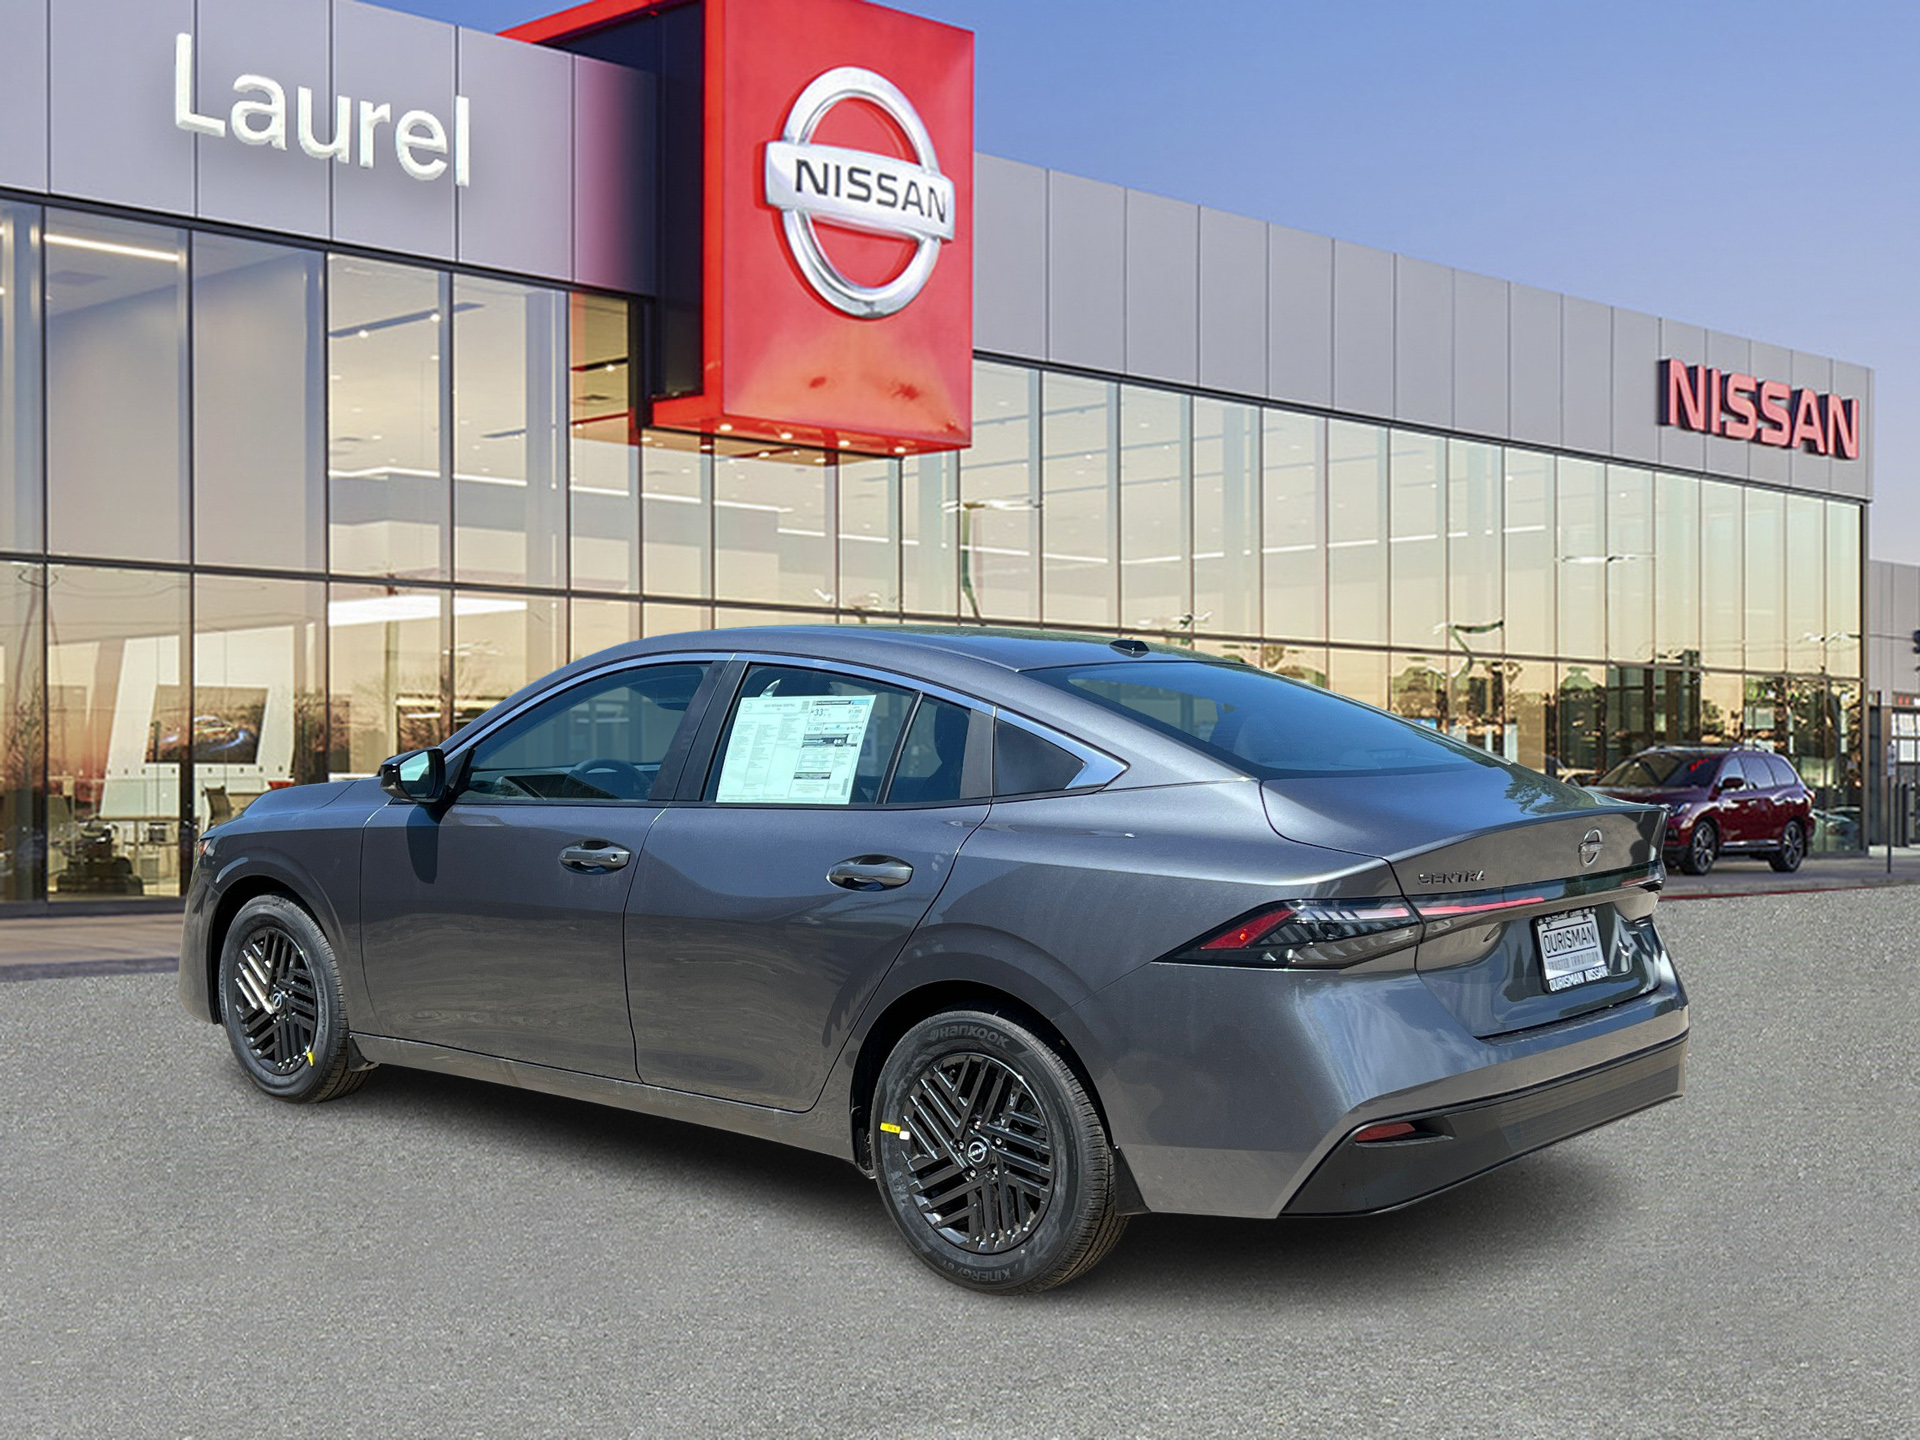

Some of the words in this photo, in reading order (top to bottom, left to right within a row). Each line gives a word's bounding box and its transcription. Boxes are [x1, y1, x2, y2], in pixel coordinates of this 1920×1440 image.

[175, 32, 470, 188] Laurel
[795, 158, 946, 224] NISSAN
[1657, 358, 1860, 460] NISSAN
[1418, 870, 1485, 885] SENTRA
[1543, 926, 1596, 953] OURISMAN
[1549, 972, 1585, 992] OURISMAN
[1585, 966, 1609, 982] NISSAN
